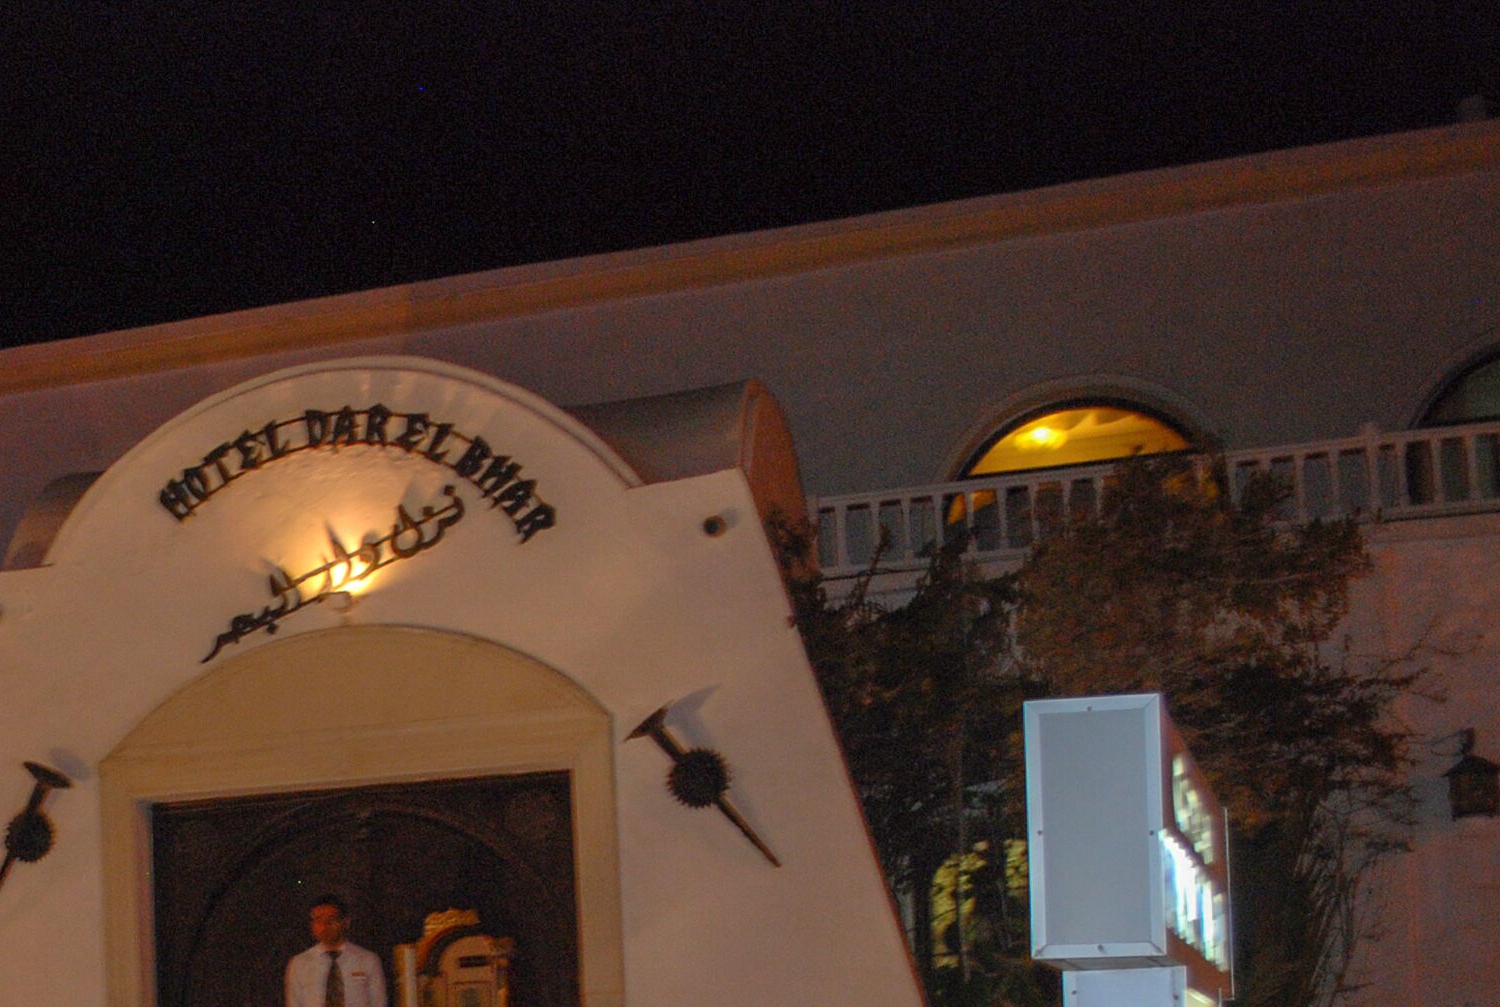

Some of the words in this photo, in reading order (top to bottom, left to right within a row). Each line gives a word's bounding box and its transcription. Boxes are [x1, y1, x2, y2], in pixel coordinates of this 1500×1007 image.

[159, 419, 290, 522] HOTEL
[304, 404, 392, 447] DAR
[395, 412, 454, 465] EL
[454, 435, 556, 545] BHAR
